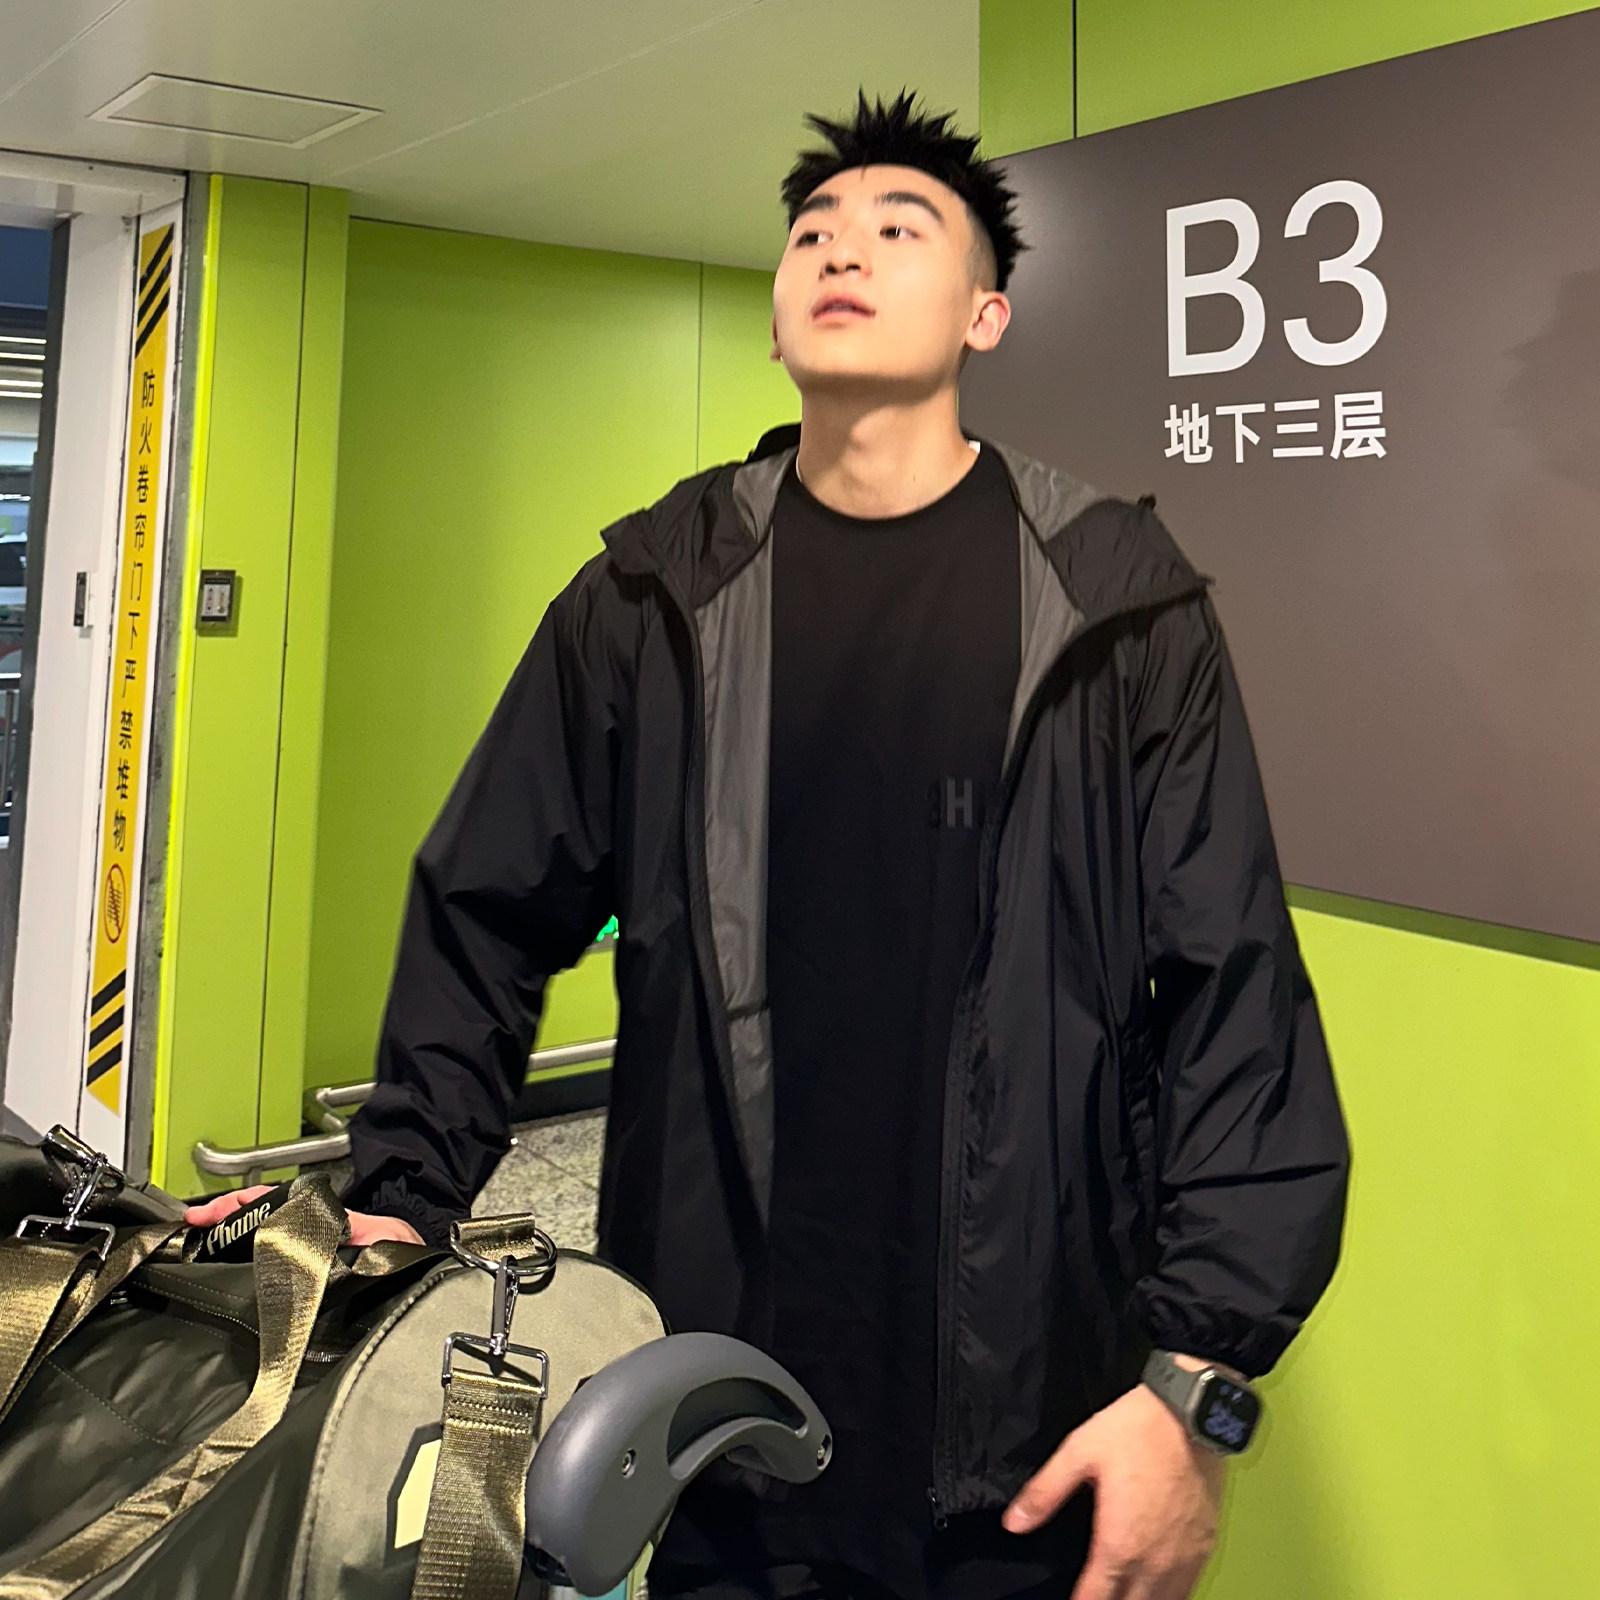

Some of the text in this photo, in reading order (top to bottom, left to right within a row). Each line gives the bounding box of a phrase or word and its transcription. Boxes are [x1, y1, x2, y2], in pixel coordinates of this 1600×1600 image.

[1166, 179, 1388, 377] B3
[1164, 391, 1387, 464] 地下三层
